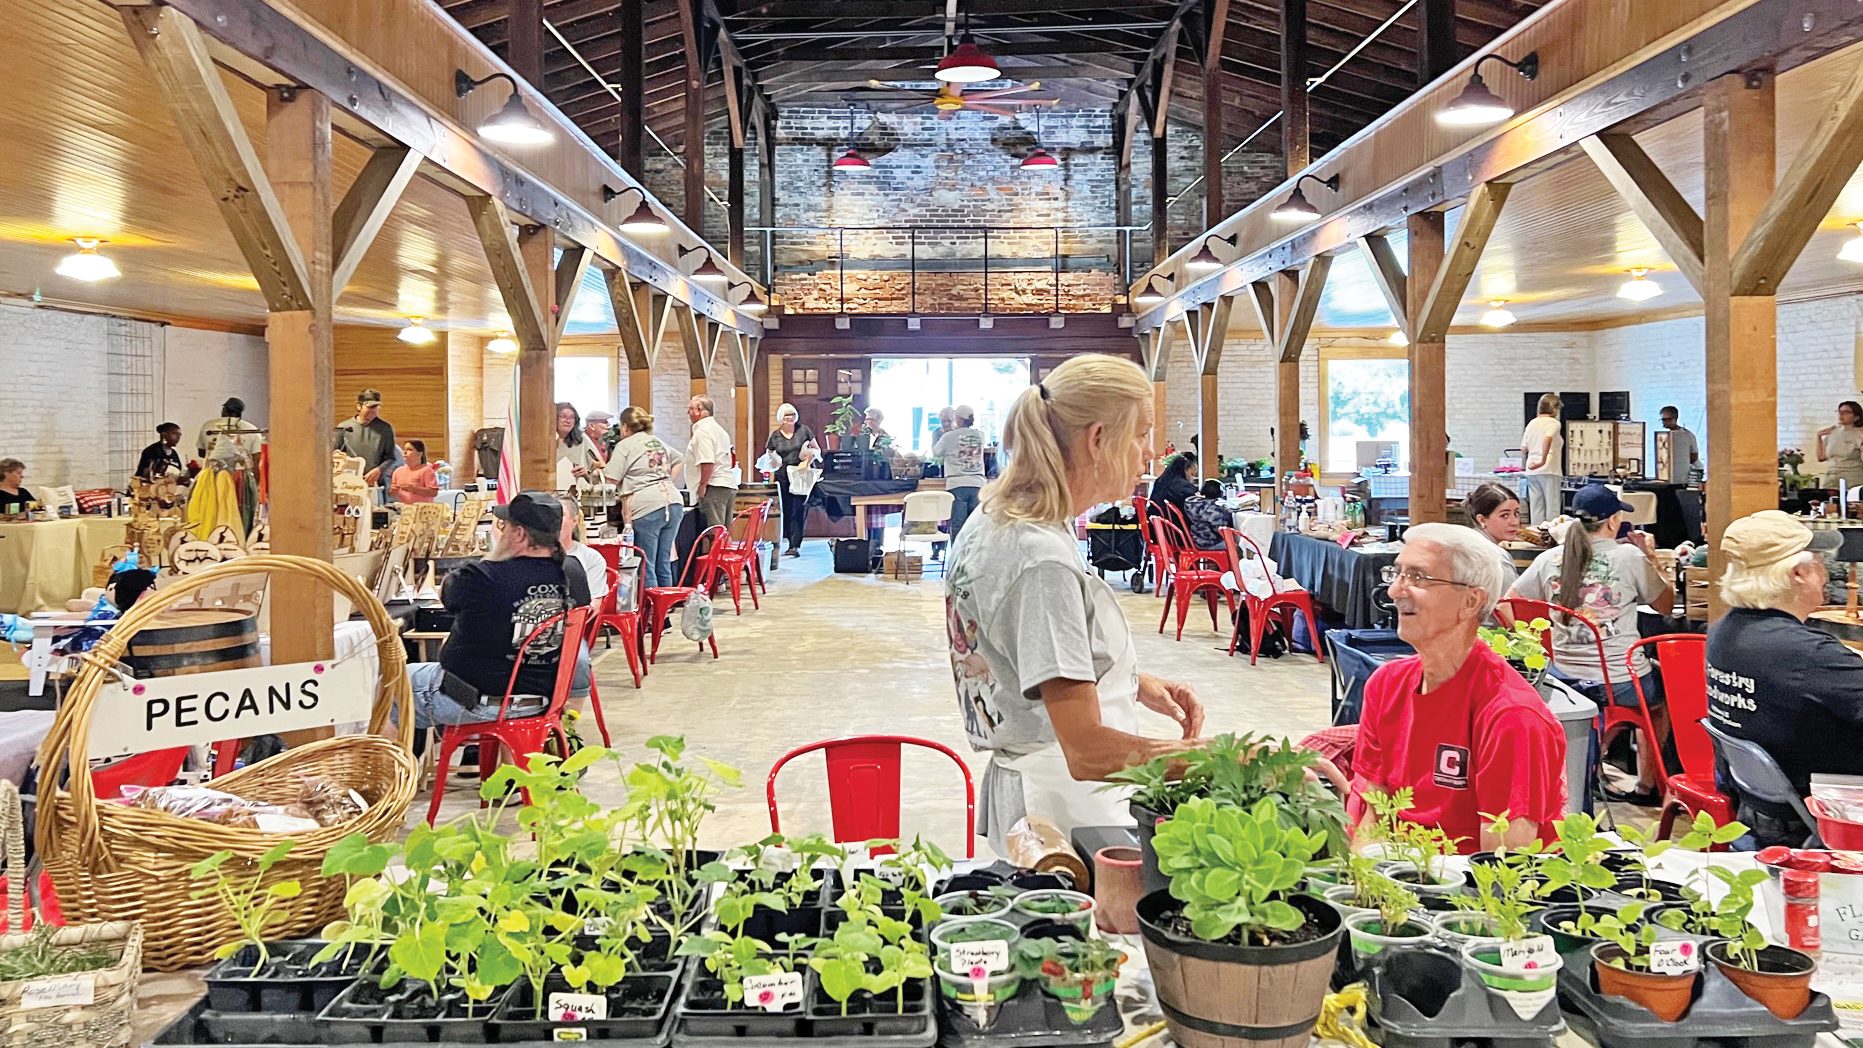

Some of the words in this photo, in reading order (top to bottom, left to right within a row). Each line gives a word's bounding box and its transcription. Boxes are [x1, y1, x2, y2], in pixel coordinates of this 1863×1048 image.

[146, 679, 319, 732] PECANS
[1440, 750, 1460, 776] C
[1654, 944, 1677, 955] Four
[554, 999, 595, 1013] Squash
